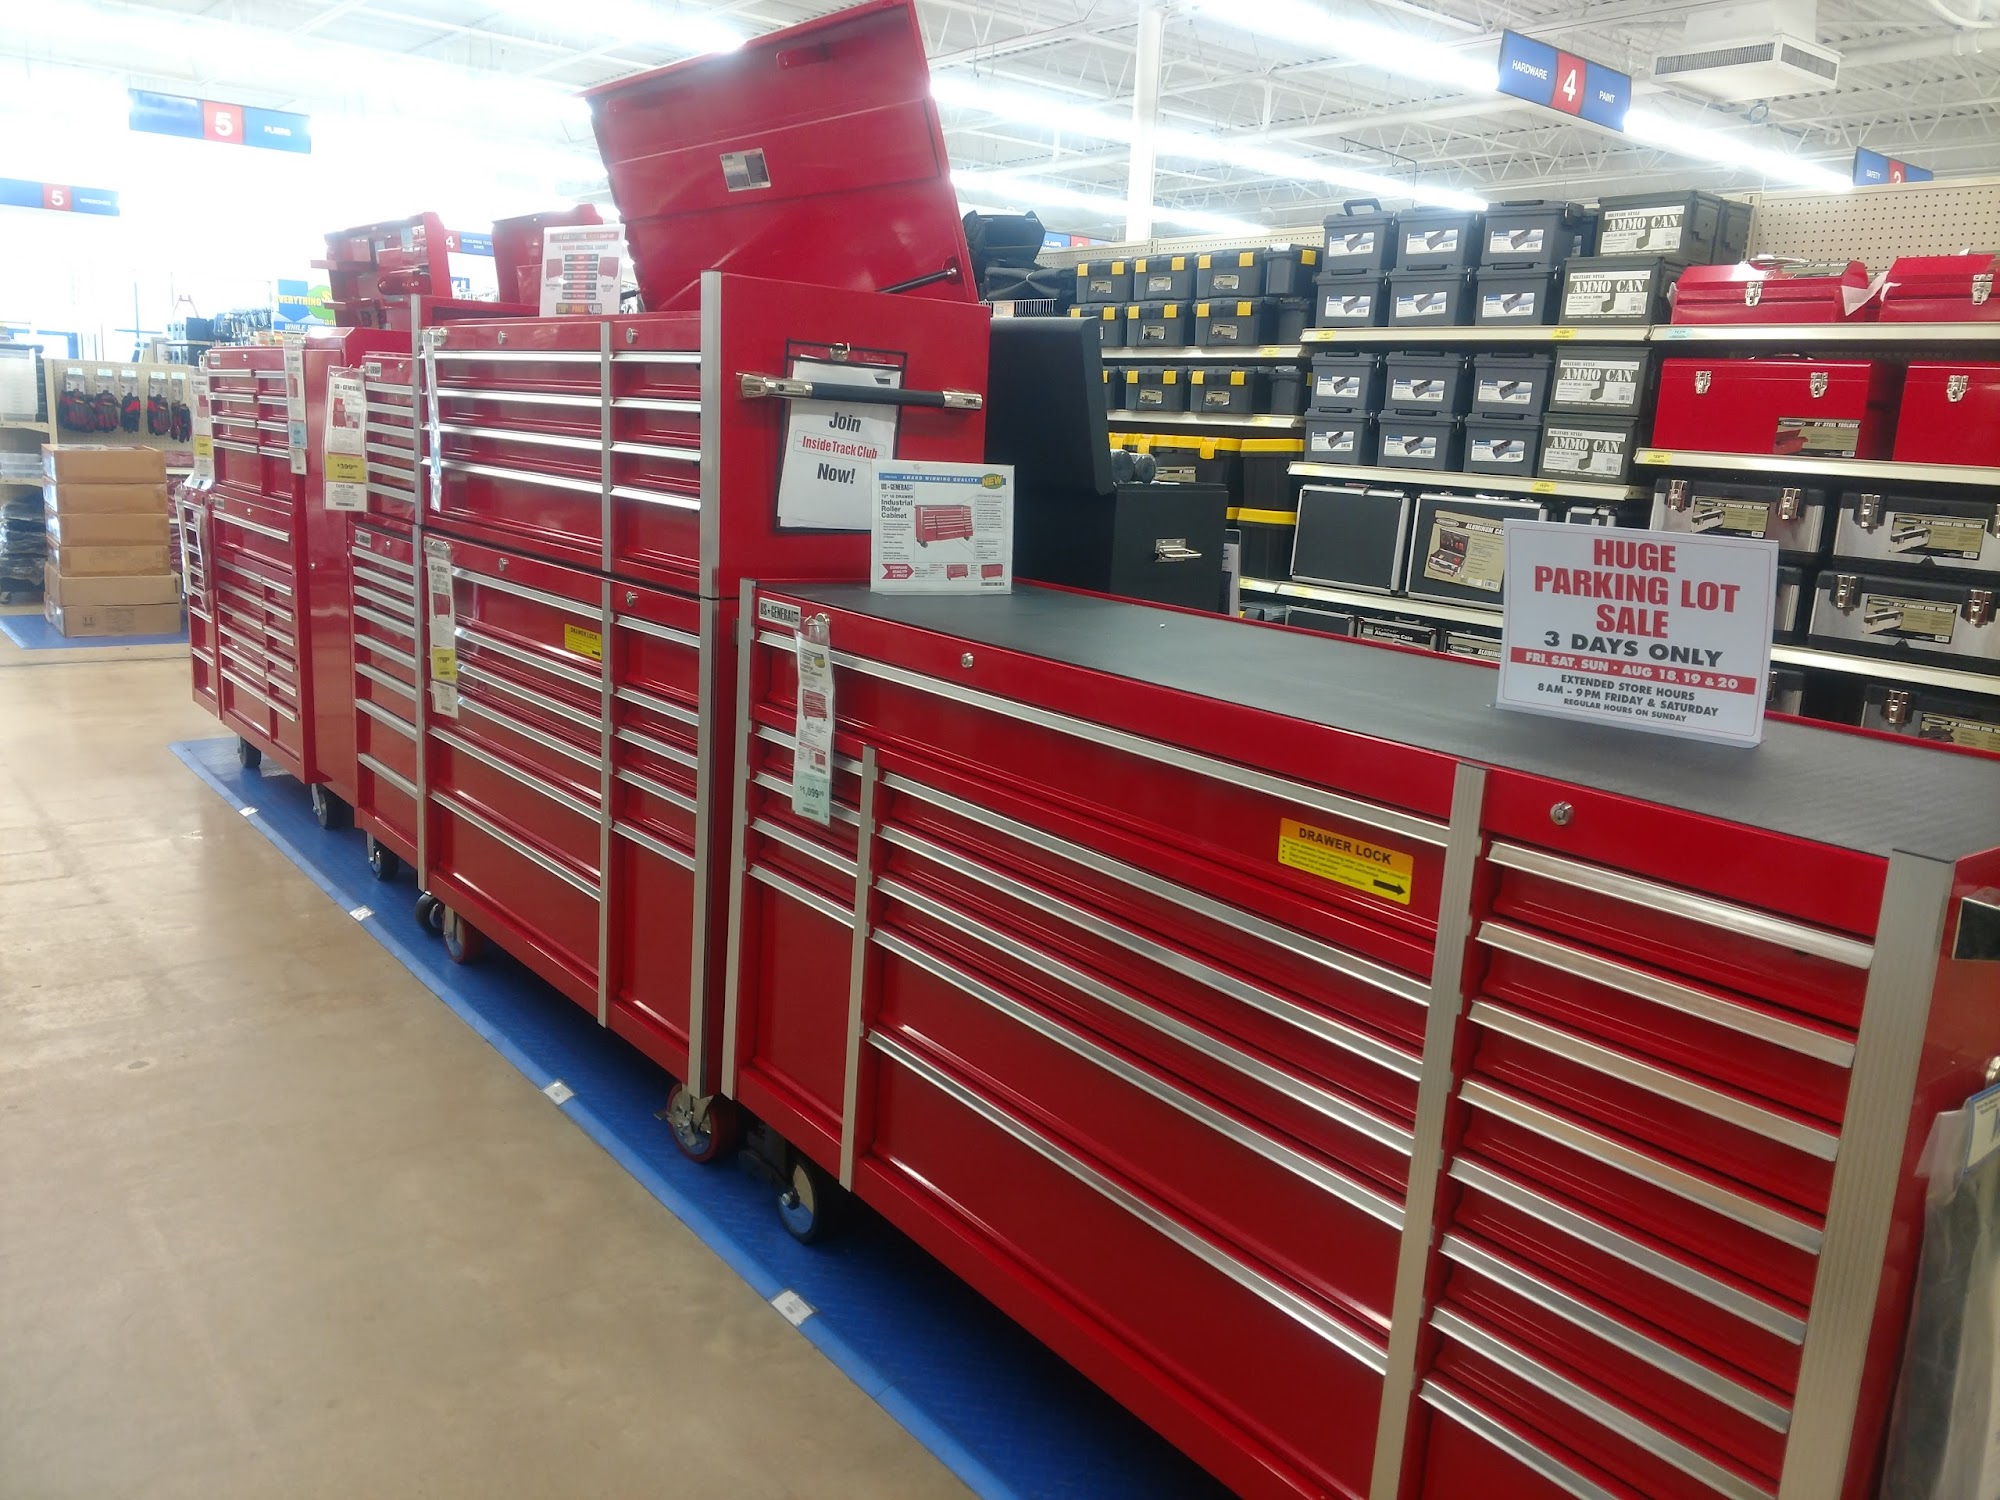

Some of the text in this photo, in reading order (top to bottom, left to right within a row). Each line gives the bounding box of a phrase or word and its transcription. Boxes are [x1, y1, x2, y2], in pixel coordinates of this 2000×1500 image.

[1512, 59, 1615, 104] HARDWARE 4 PAINT
[214, 111, 233, 136] 5
[1866, 169, 1881, 180] SAFETY
[51, 189, 64, 206] 5
[1608, 214, 1680, 232] AMMO CAN
[445, 236, 455, 248] 4
[1572, 280, 1644, 294] AMMO CAN
[284, 322, 306, 332] WHILE
[1562, 368, 1634, 382] AMMO CAN
[828, 411, 862, 432] Join
[802, 436, 878, 460] Inside Track Club
[1550, 437, 1620, 454] AMMO CAN
[817, 462, 856, 484] Now!
[982, 474, 1004, 488] NEW
[1466, 523, 1494, 534] ALUMINUM
[1593, 538, 1676, 573] HUGE
[1535, 566, 1740, 612] PARKING LOT
[760, 602, 794, 622] US GENERAL
[1596, 604, 1669, 639] SALE
[570, 627, 586, 637] DRAWER
[1374, 630, 1400, 640] Aluminum
[1544, 630, 1723, 668] 3 DAYS ONLY
[1581, 658, 1609, 672] SUN
[1622, 664, 1652, 678] AUG
[1684, 672, 1701, 684] 19
[1705, 677, 1714, 686] &
[1717, 677, 1738, 689] 20
[1561, 674, 1695, 701] EXTENDED STORE HOURS
[1564, 698, 1686, 722] REGULAR HOURS ON SUNDAY
[1604, 692, 1643, 706] FRIDAY
[1647, 698, 1656, 707] &
[1660, 700, 1718, 716] SATURDAY
[1298, 828, 1352, 853] DRAWER
[1356, 844, 1392, 865] LOCK
